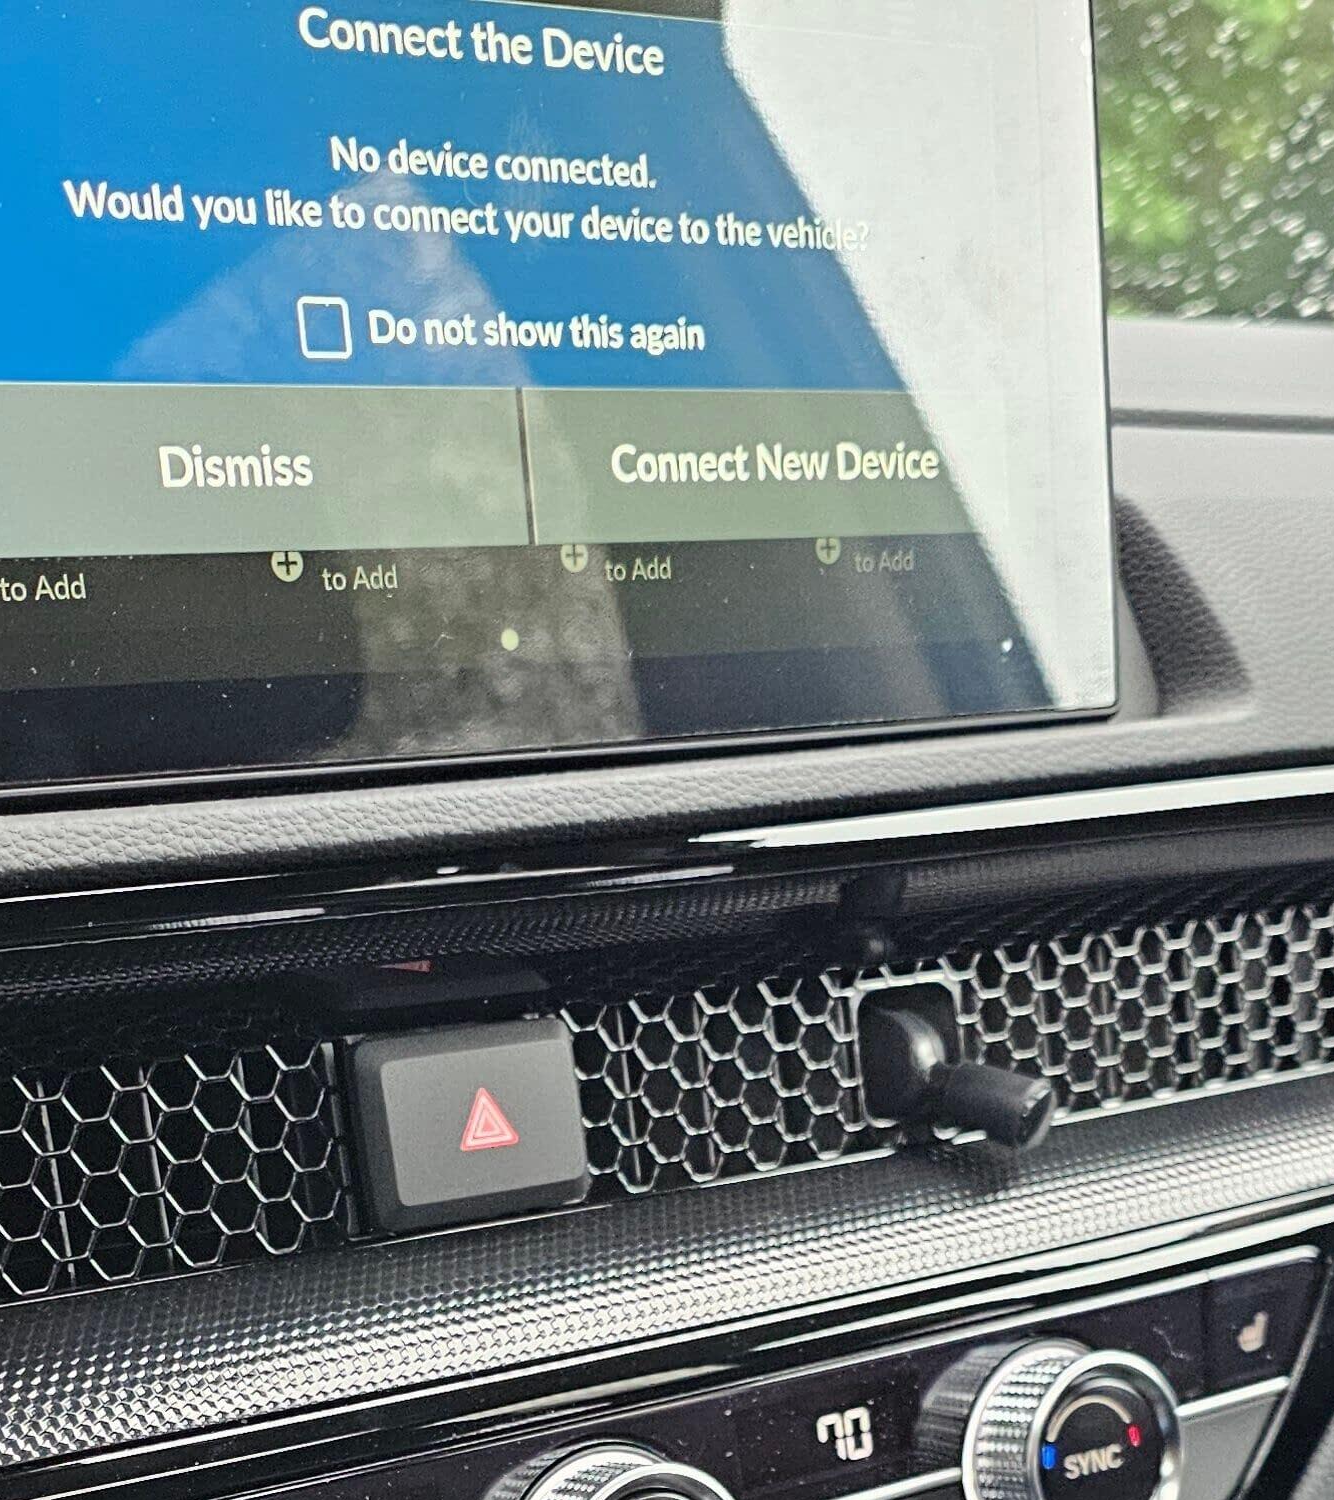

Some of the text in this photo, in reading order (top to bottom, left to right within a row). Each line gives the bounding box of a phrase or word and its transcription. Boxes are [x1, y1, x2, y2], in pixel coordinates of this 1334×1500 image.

[299, 7, 665, 76] Connect the Device
[330, 136, 657, 189] No device connected.
[63, 180, 869, 251] Would you like to connect your device to the vehicle?
[368, 310, 706, 356] Do not show this again
[158, 443, 314, 489] Dismiss
[611, 441, 940, 483] Connect New Device
[321, 563, 399, 592] to Add
[605, 555, 673, 582] to Add
[854, 548, 915, 574] to Add
[34, 572, 87, 601] Add
[816, 1407, 875, 1462] 70
[1064, 1443, 1125, 1481] SYNC
